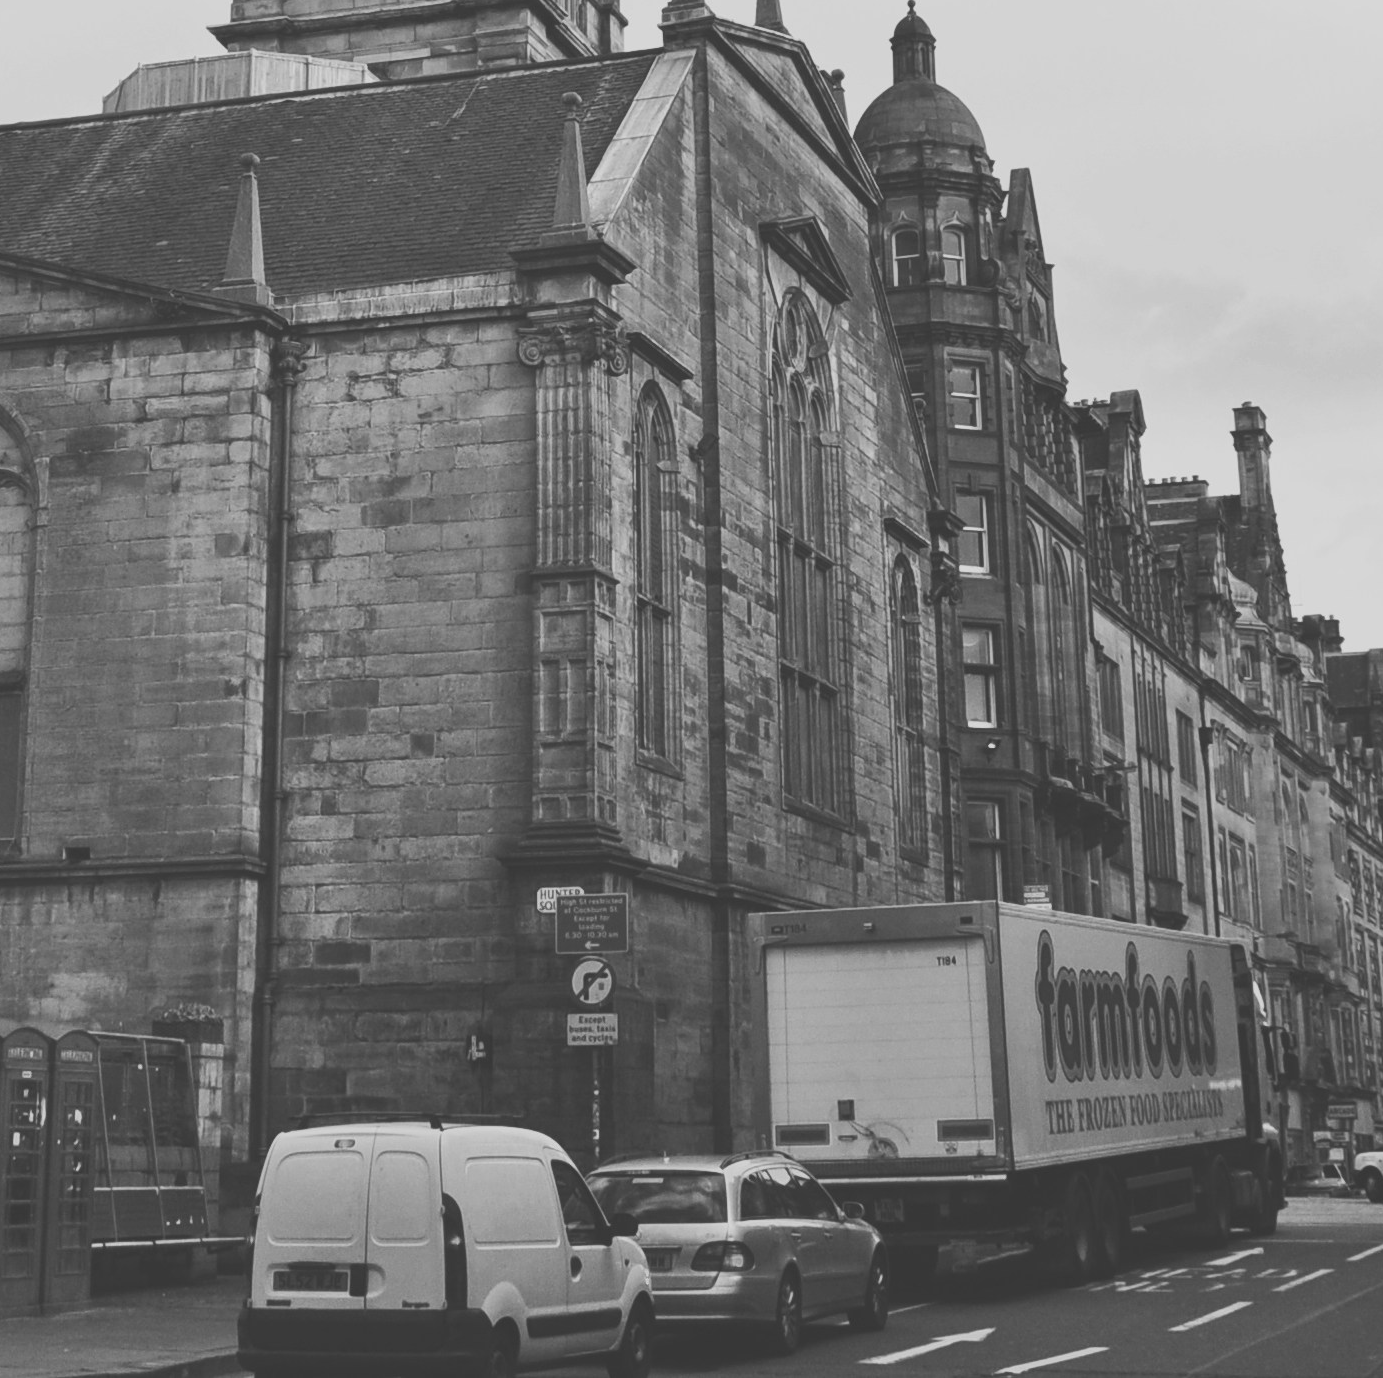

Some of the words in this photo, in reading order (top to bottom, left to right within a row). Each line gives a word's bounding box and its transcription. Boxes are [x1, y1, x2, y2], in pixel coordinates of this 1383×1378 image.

[560, 898, 577, 906] High
[588, 897, 623, 905] restricted
[573, 915, 598, 923] Except
[783, 924, 807, 934] T184
[936, 955, 957, 967] T184
[1035, 928, 1218, 1083] farmfoods
[578, 1015, 606, 1024] Except
[588, 1035, 613, 1043] cycles
[1045, 1099, 1074, 1135] THE
[1076, 1095, 1127, 1132] FROZEN
[1128, 1093, 1161, 1126] FOOD
[1162, 1088, 1223, 1123] SPECIALISTS
